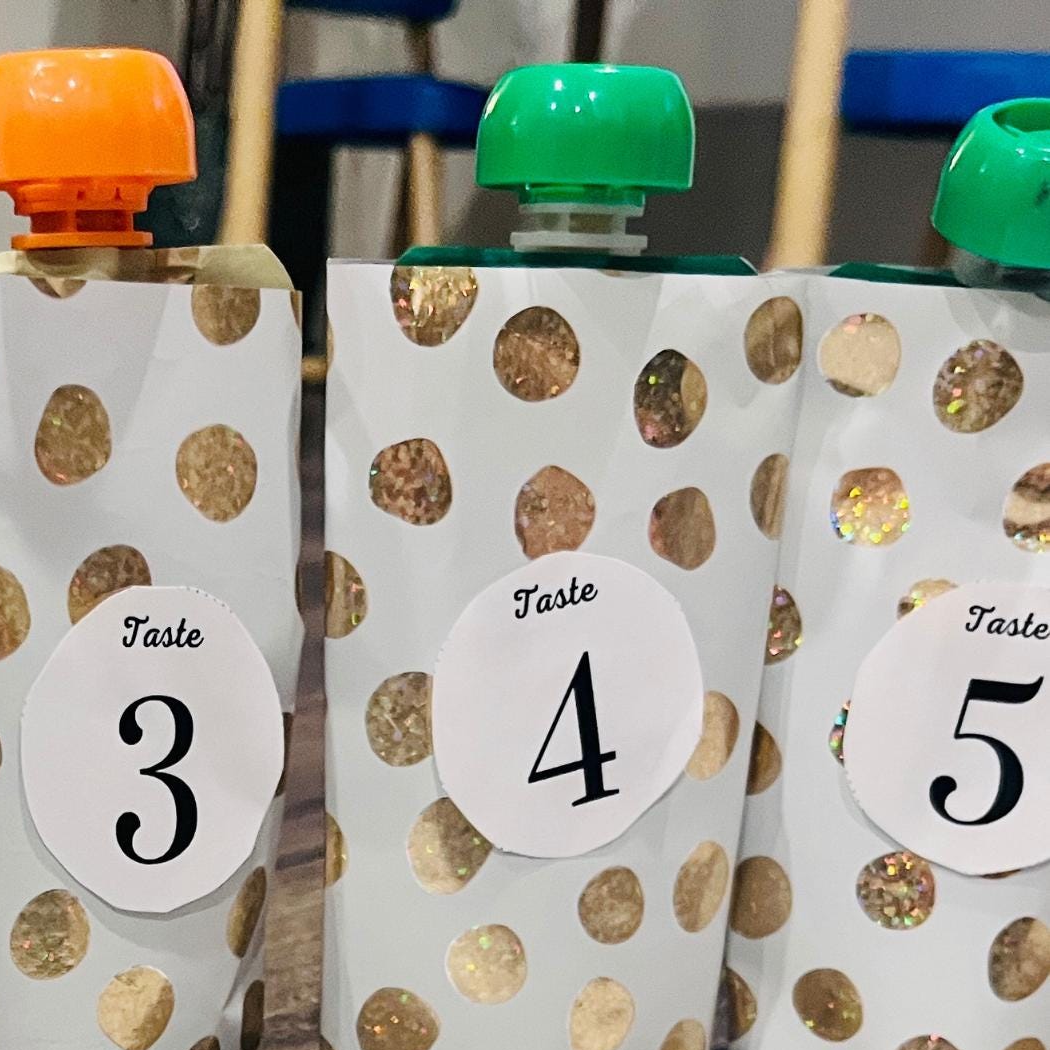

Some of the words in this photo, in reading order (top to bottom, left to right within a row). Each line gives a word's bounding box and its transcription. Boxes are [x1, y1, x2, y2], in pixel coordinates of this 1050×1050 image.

[122, 615, 205, 649] Taste
[513, 576, 599, 620] Taste
[964, 604, 1050, 640] Taste
[528, 650, 621, 808] 4
[928, 675, 1045, 827] 5
[115, 694, 198, 866] 3
